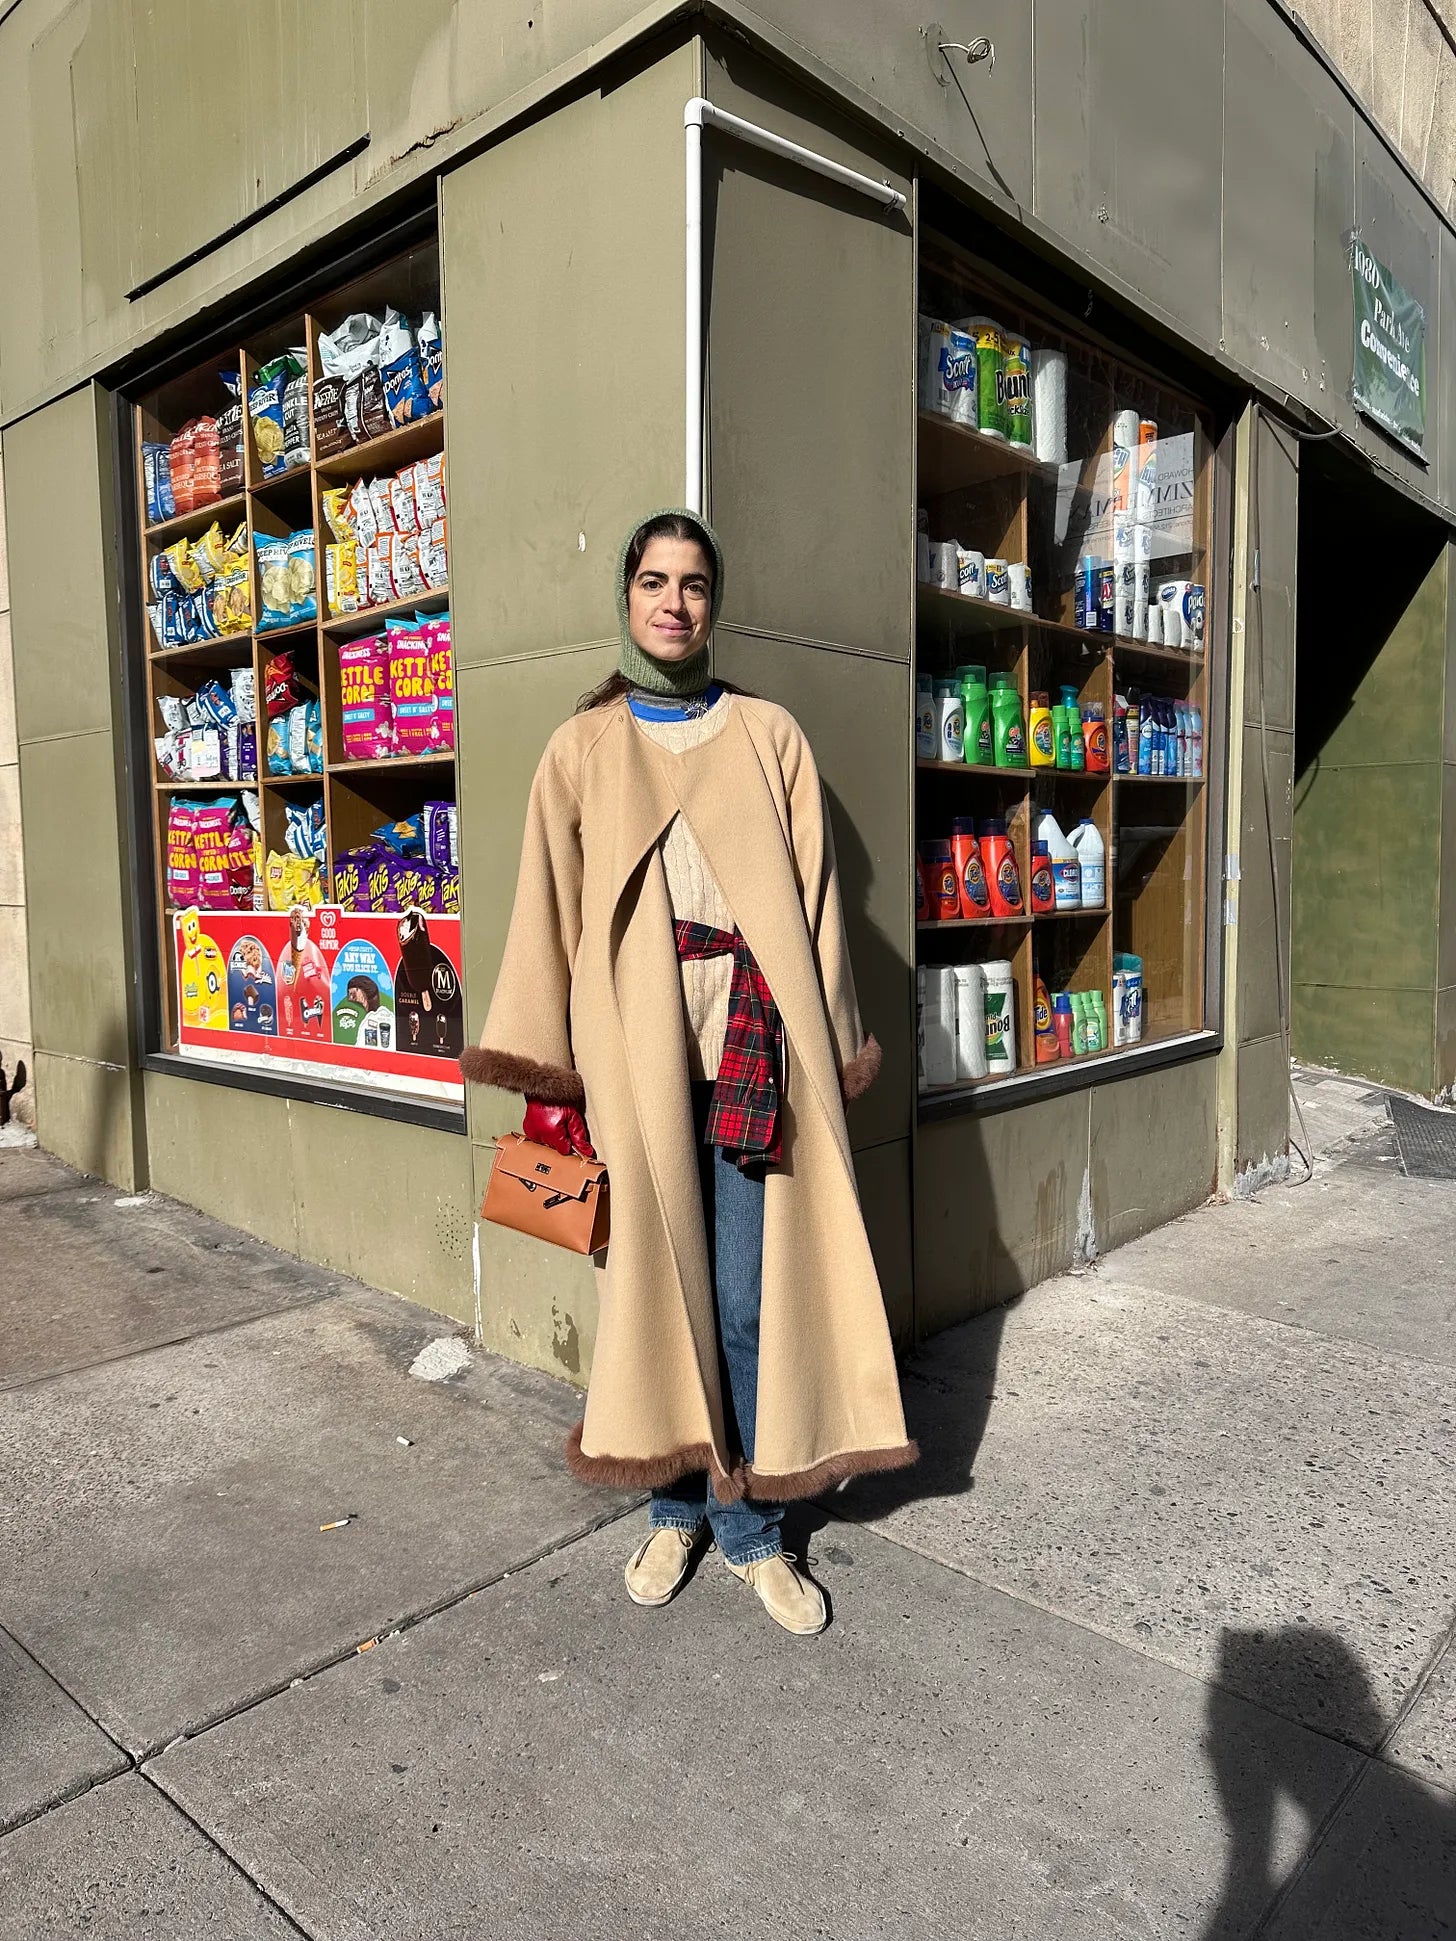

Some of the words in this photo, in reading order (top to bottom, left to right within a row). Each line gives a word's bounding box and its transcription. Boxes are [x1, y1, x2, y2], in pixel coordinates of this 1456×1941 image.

[1354, 245, 1380, 289] 1080
[1373, 297, 1397, 340] Park
[946, 353, 971, 379] Scott
[383, 365, 412, 394] Doritos
[960, 563, 975, 579] cott
[342, 684, 375, 706] CORN
[395, 676, 435, 698] CORN
[194, 831, 231, 850] KETTLE
[169, 852, 197, 869] CORN
[199, 854, 230, 872] CORN
[335, 868, 359, 903] Takis
[321, 927, 336, 939] GOOD
[437, 970, 451, 989] M
